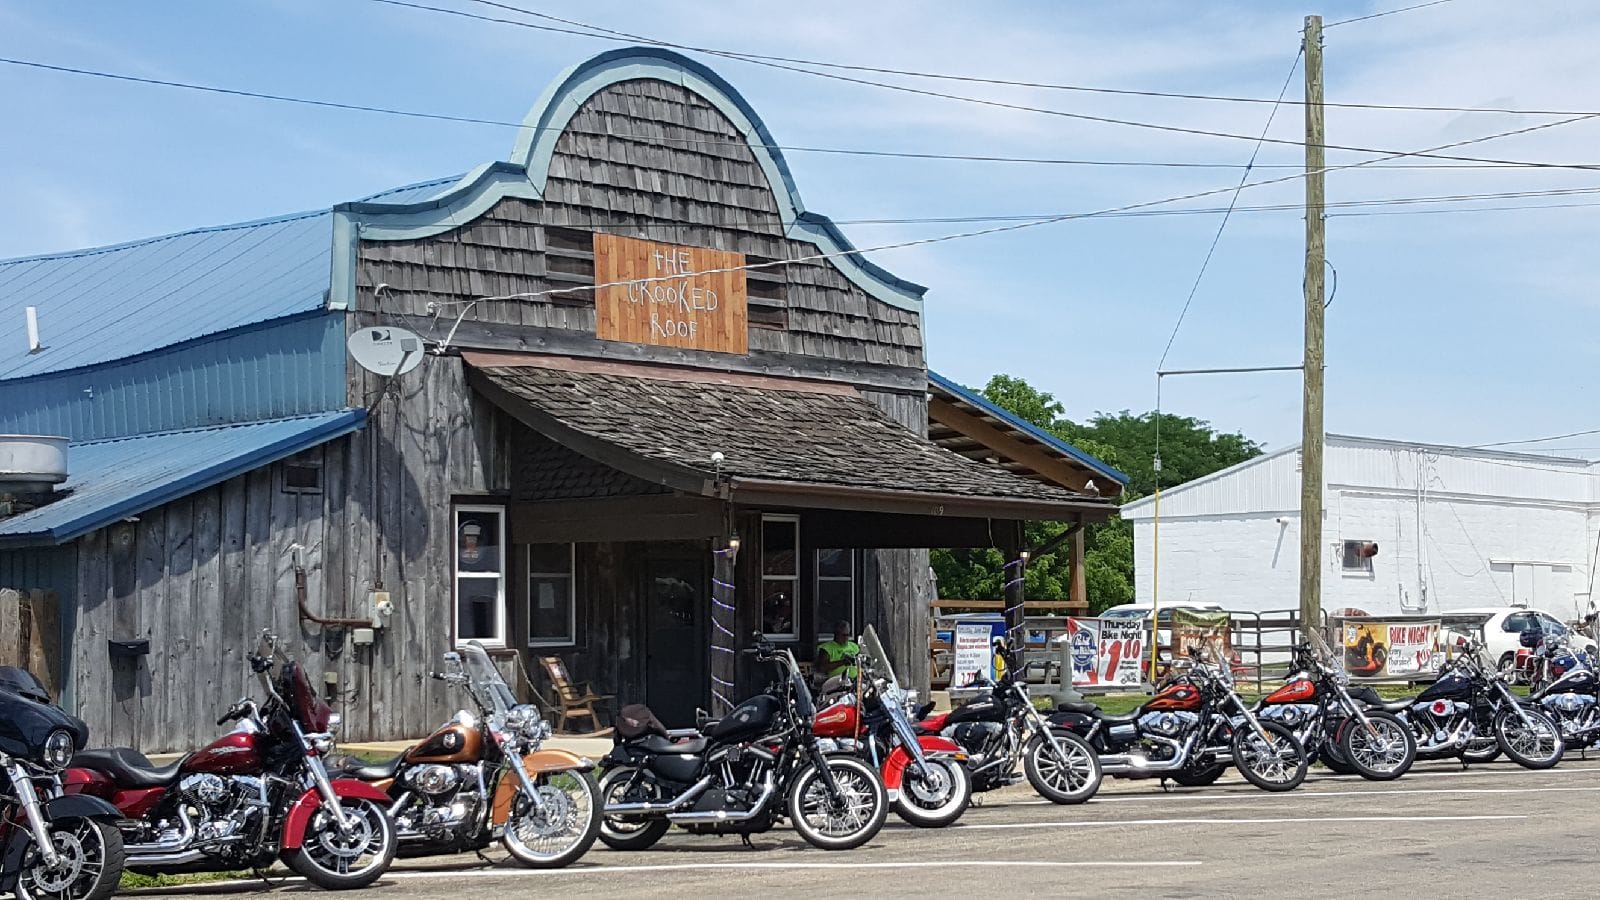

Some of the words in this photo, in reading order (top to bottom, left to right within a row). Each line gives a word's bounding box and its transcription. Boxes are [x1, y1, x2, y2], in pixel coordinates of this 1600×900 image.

[627, 280, 718, 313] CROOKED
[651, 312, 698, 340] ROOF
[1101, 631, 1118, 639] Bike
[1104, 620, 1141, 630] Thursday
[1390, 626, 1406, 644] BIKE
[1408, 624, 1431, 644] NIGHT
